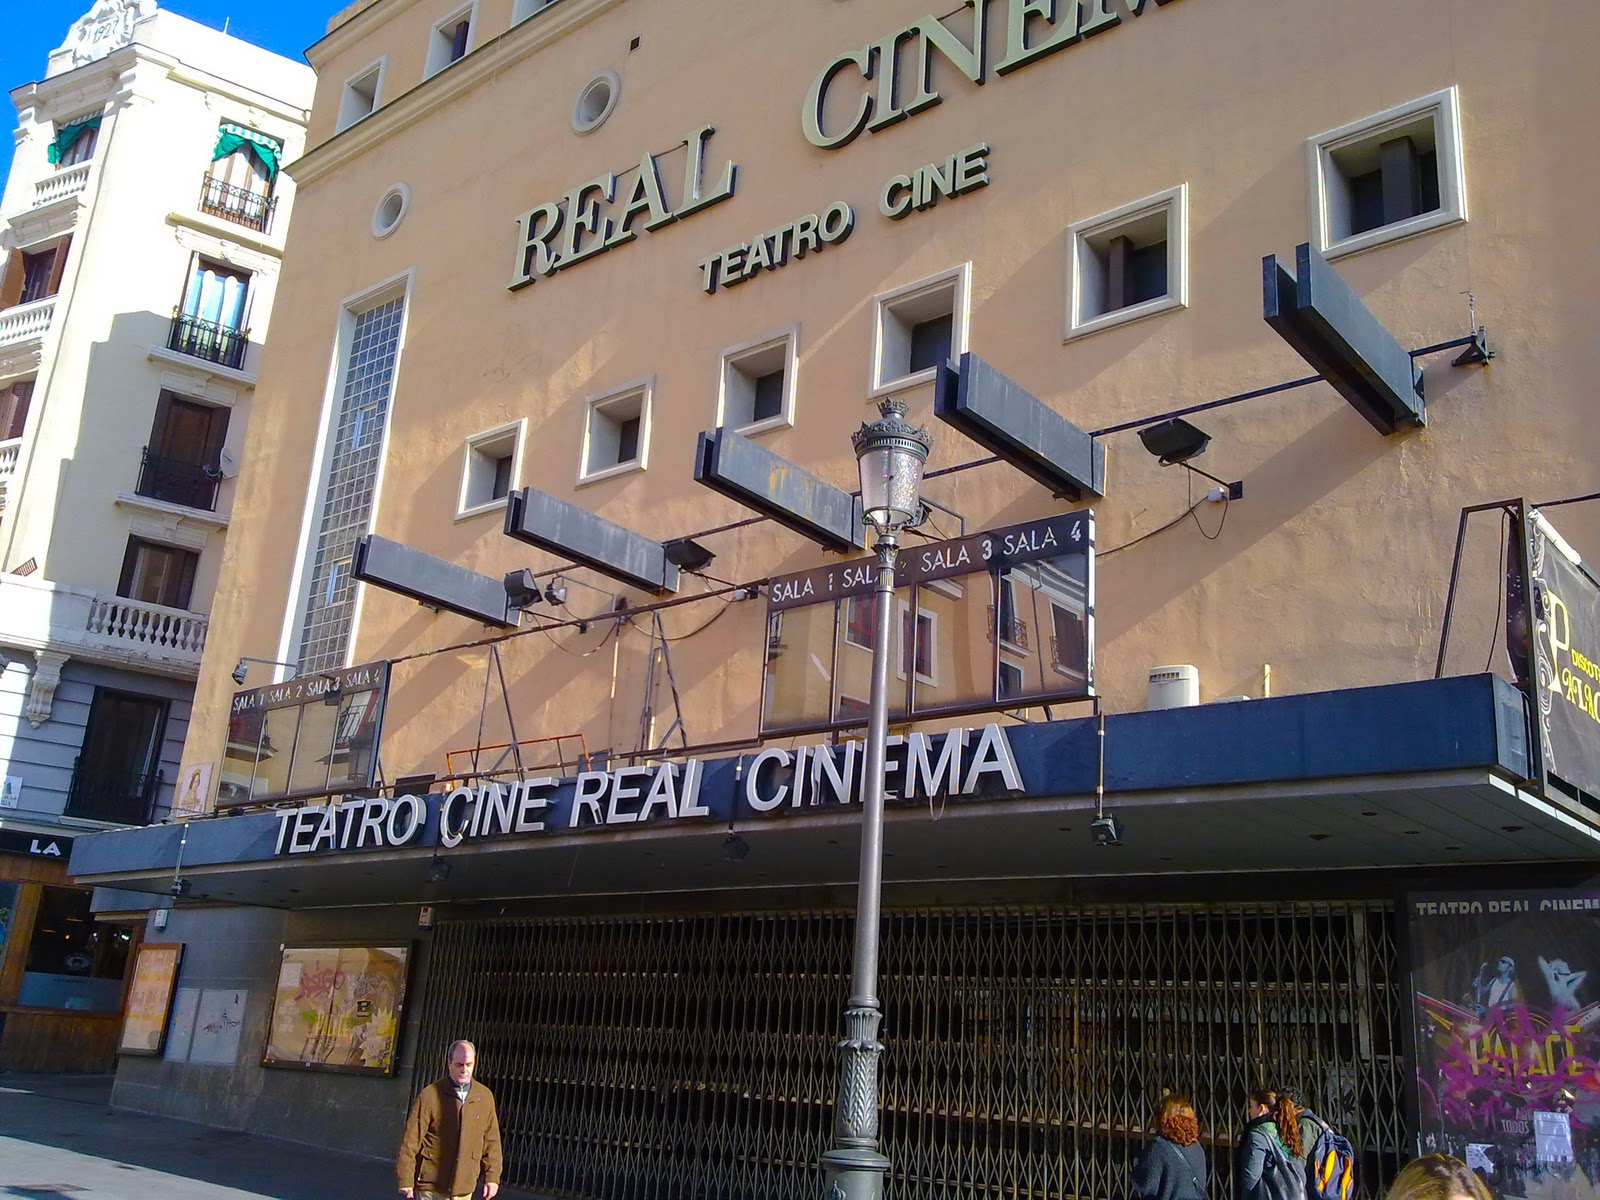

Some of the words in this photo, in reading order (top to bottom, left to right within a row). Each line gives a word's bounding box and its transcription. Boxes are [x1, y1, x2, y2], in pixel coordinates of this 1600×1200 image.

[507, 124, 738, 292] REAL
[802, 0, 1172, 150] CINE
[699, 200, 856, 294] TEATRO
[878, 142, 990, 221] CINE
[772, 577, 815, 603] SALA
[842, 564, 880, 588] SAL
[920, 544, 972, 573] SALA
[981, 538, 994, 562] 3
[1002, 526, 1058, 555] SALA
[1070, 520, 1082, 543] 4
[232, 697, 255, 714] SALA
[259, 693, 265, 706] 1
[268, 690, 291, 703] SALA
[295, 685, 303, 698] 2
[307, 679, 331, 697] SALA
[333, 676, 342, 692] 3
[345, 669, 371, 688] SALA
[1571, 648, 1600, 684] DISCOT
[274, 794, 426, 855] TEATRO
[440, 777, 559, 848] CINE
[569, 758, 710, 828] REAL
[746, 723, 1025, 812] CINEMA
[29, 838, 62, 858] LA
